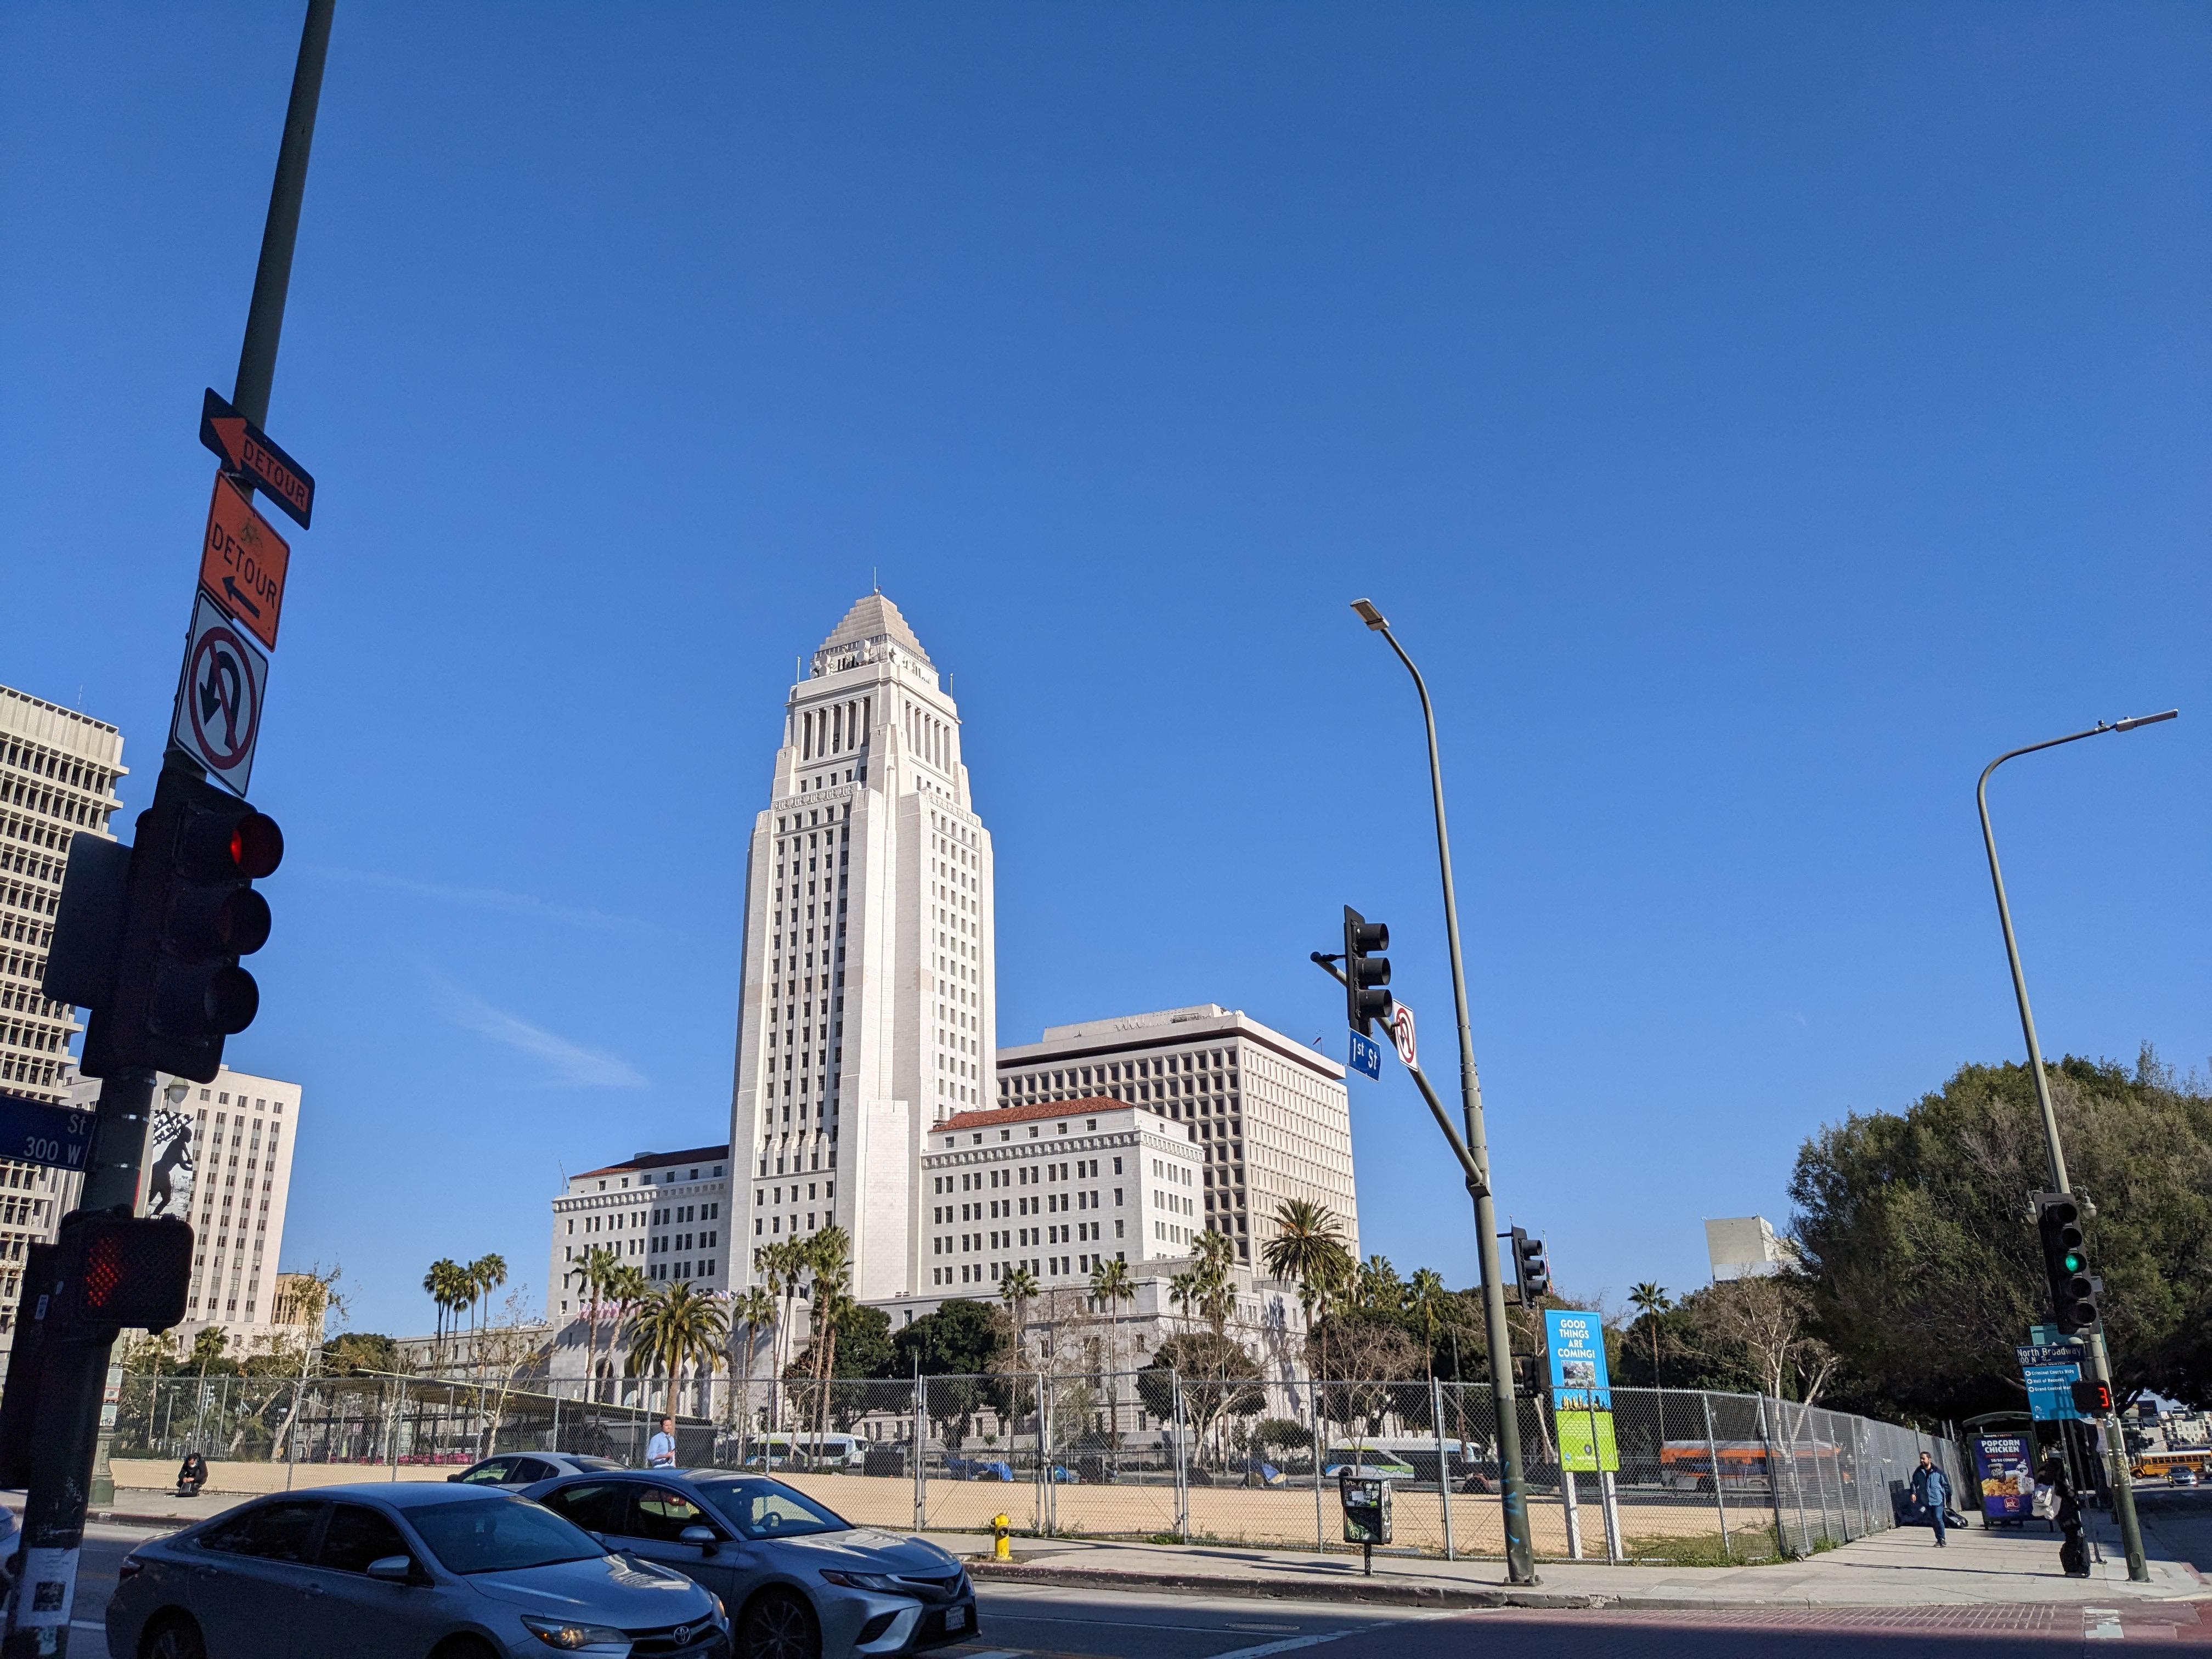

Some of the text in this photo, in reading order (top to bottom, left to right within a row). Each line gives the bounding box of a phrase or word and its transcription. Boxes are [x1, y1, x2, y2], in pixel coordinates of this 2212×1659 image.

[242, 439, 306, 507] DETOUR
[212, 522, 277, 610] DETOUR
[1353, 1037, 1378, 1070] 1st St
[67, 1114, 87, 1135] St
[23, 1136, 82, 1165] 300 W
[1560, 1319, 1586, 1329] GOOD
[1559, 1329, 1589, 1339] THINGS
[1568, 1339, 1583, 1348] ARE
[1558, 1348, 1595, 1358] COMING!
[2017, 1347, 2081, 1357] North Broadway
[2098, 1386, 2109, 1408] 3
[1981, 1439, 2021, 1447] POPCORN
